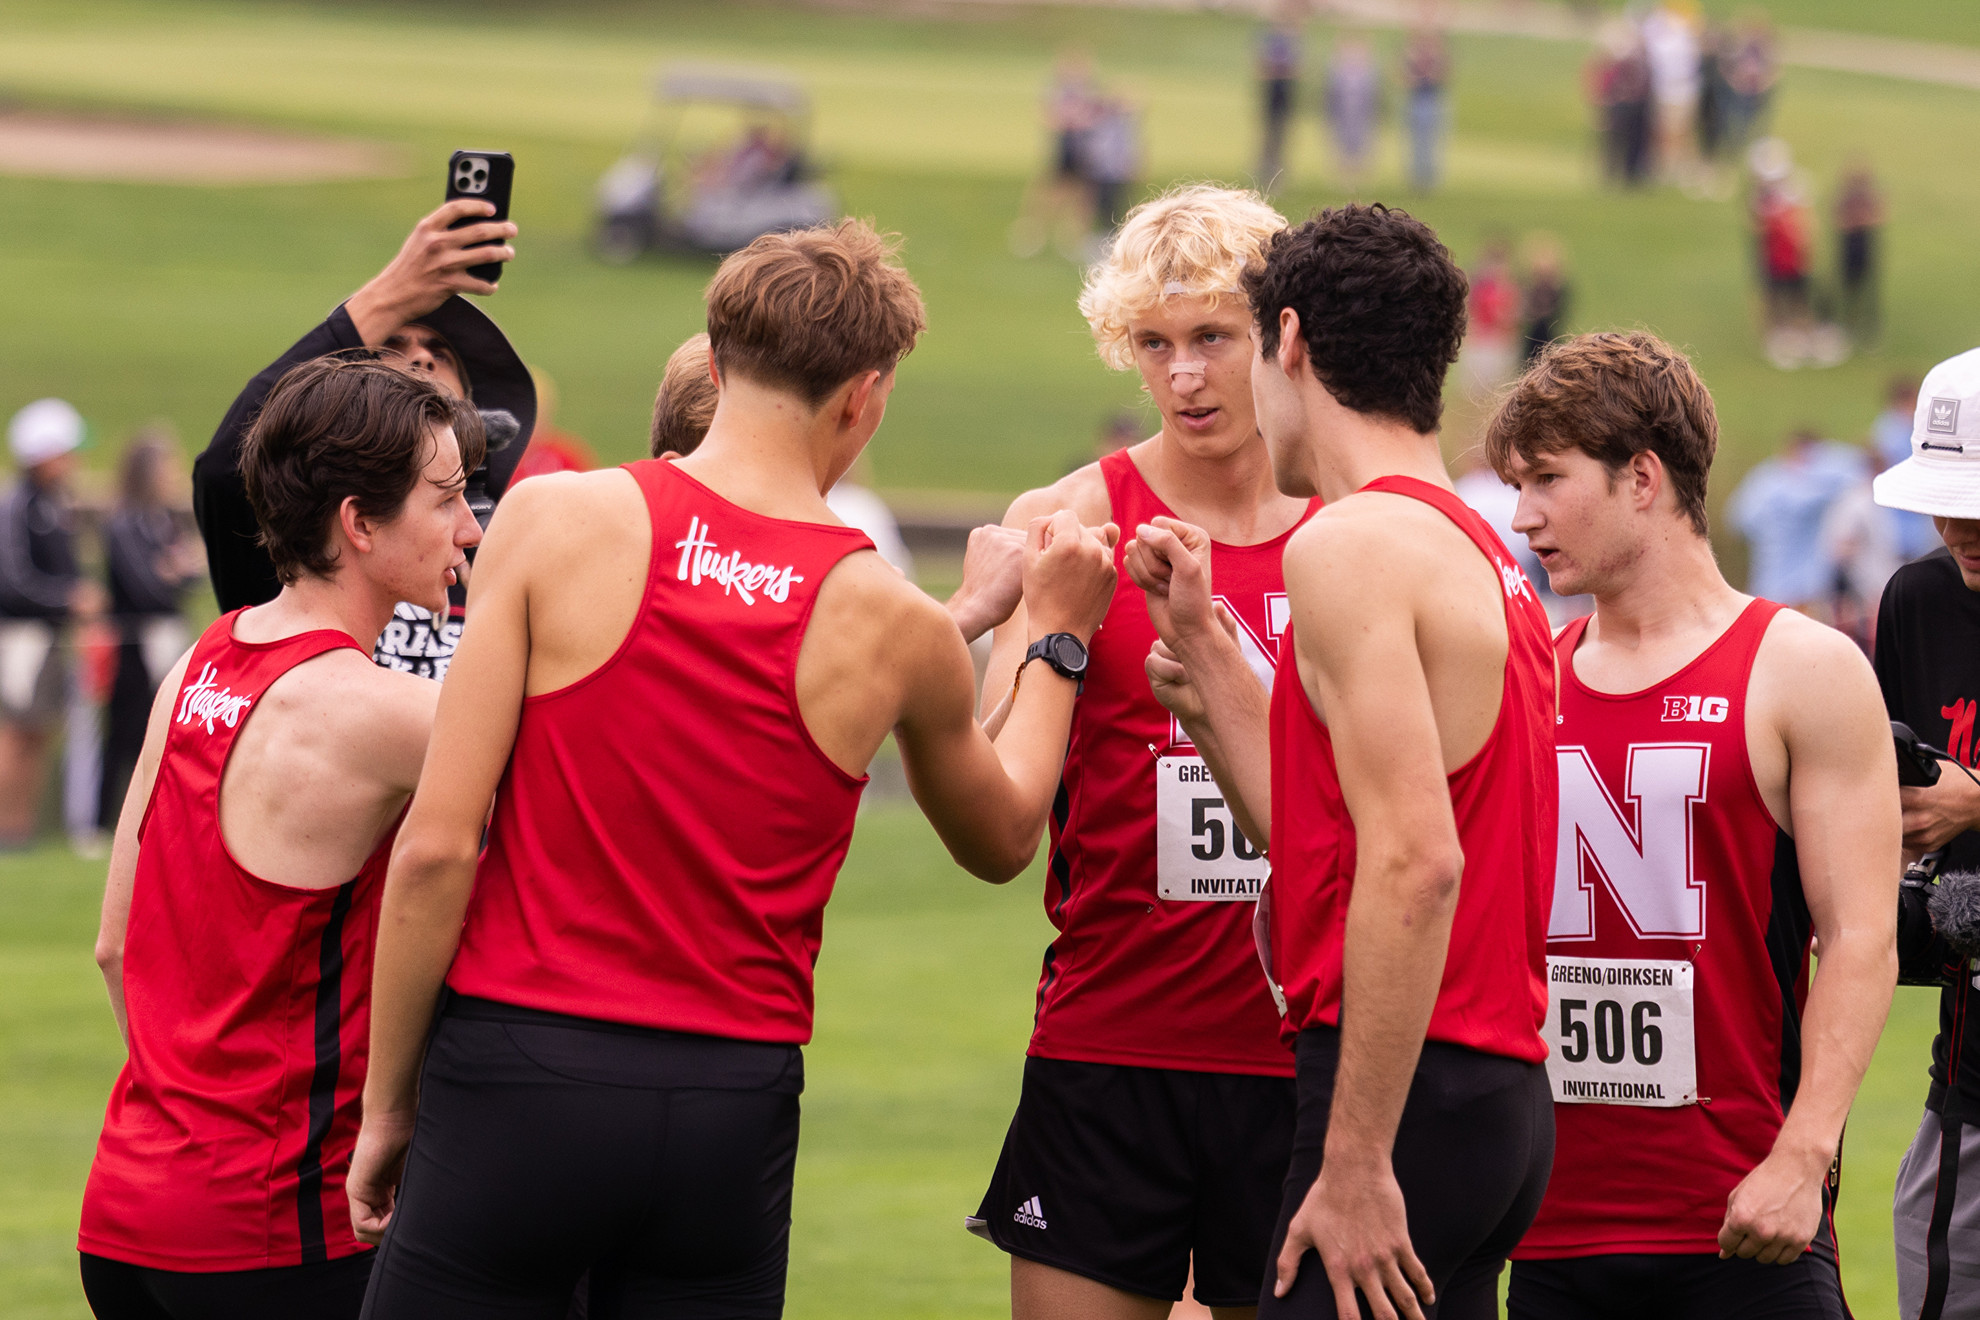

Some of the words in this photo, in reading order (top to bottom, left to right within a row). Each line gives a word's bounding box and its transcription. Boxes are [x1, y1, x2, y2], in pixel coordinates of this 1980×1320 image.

[675, 516, 804, 606] Huskers
[176, 661, 252, 735] Huskers
[1178, 765, 1215, 782] GRE
[1545, 743, 1711, 942] N
[1191, 878, 1262, 894] INVITATI
[1551, 965, 1673, 986] GREENO/DIRKSEN
[1560, 998, 1663, 1065] 506
[1562, 1080, 1665, 1099] INVITATIONAL
[1013, 1213, 1048, 1230] adidas
